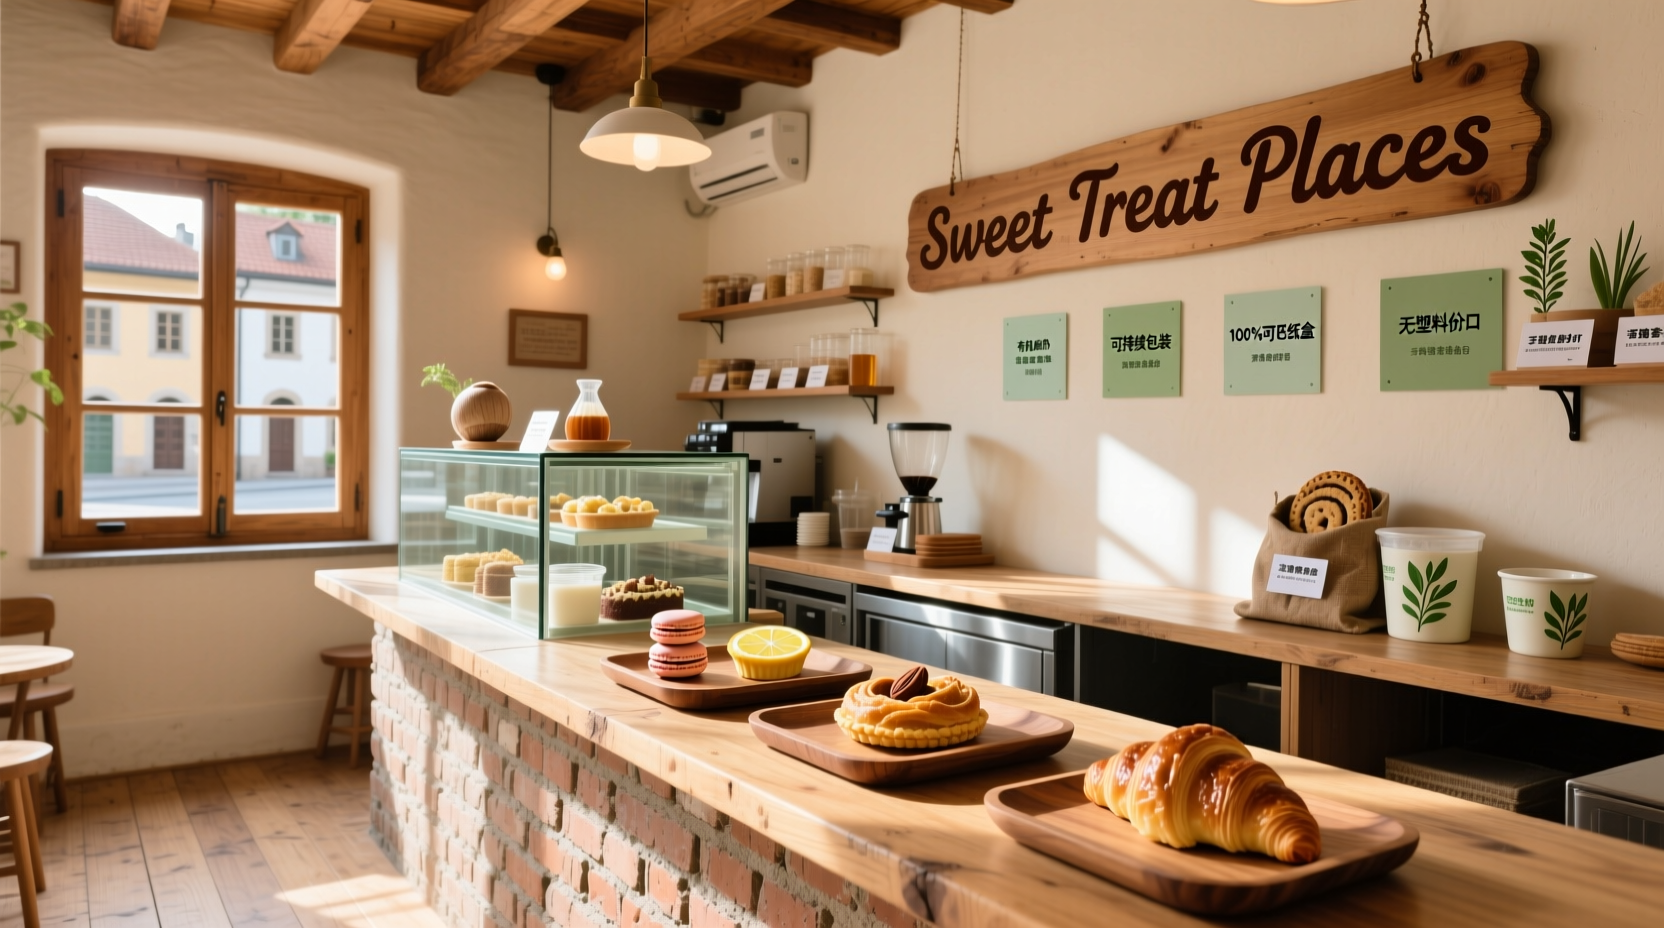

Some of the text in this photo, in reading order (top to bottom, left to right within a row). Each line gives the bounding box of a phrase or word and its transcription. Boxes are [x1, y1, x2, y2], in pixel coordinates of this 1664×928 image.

[919, 115, 1491, 271] Sweet Treat Places
